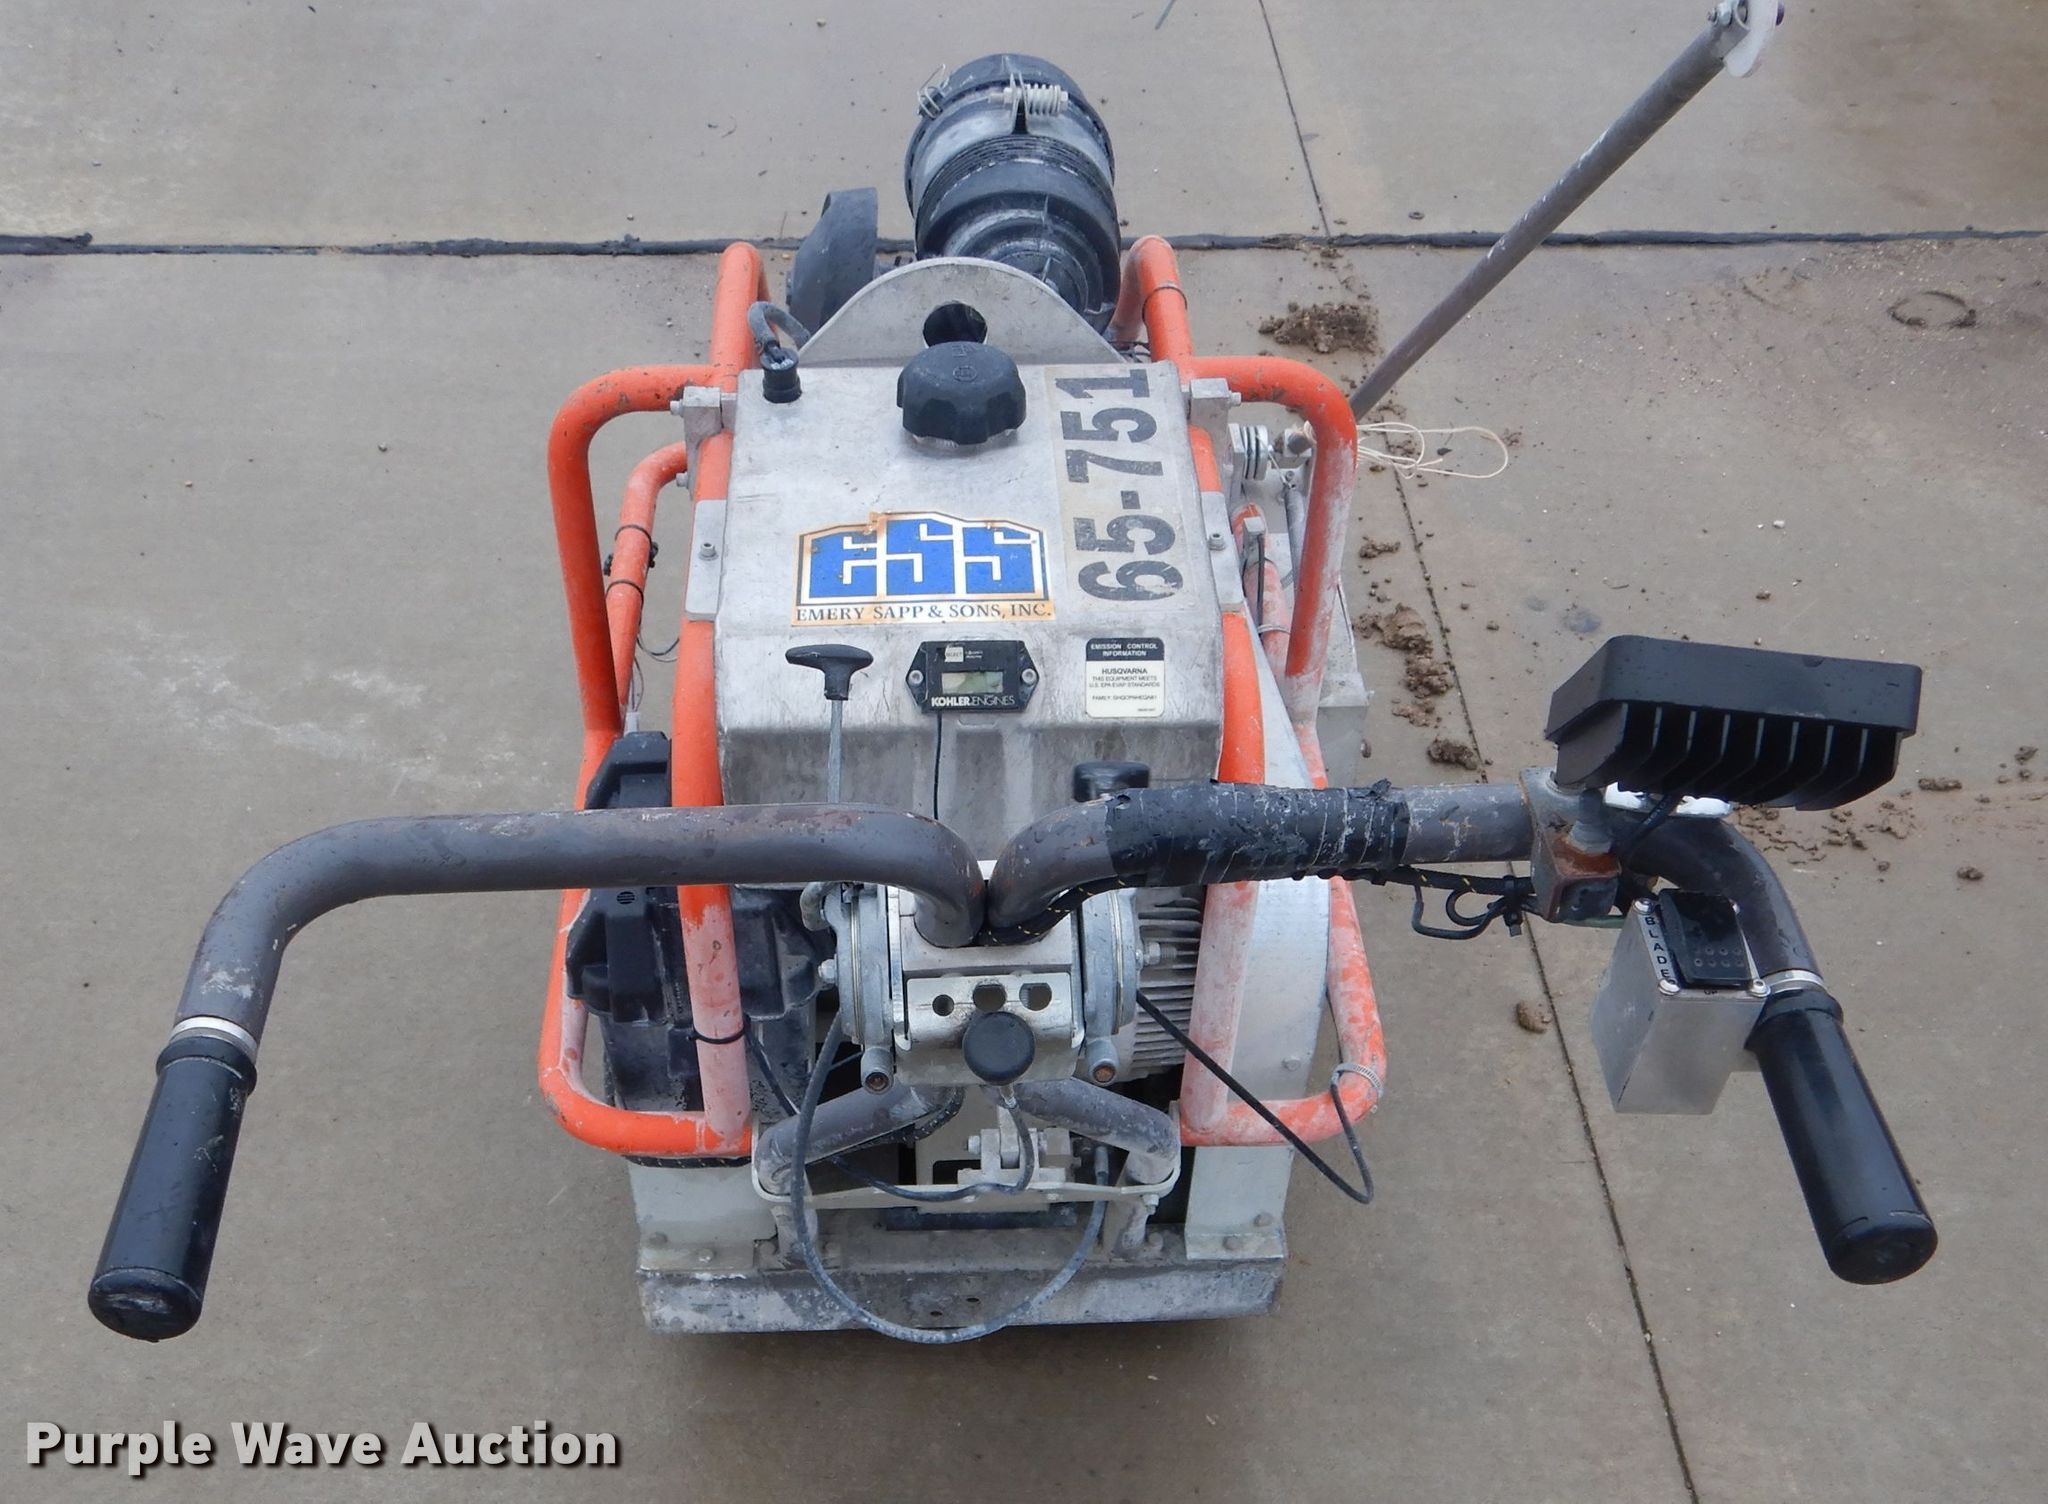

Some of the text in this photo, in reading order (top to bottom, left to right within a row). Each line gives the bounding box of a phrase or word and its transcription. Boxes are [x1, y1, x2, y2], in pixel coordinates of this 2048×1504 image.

[1055, 368, 1184, 602] 65-751
[796, 602, 1052, 622] EMERY SAPP & SONS, INC.
[1101, 667, 1148, 675] HUSQVARNA
[931, 696, 970, 708] KOHLER
[1644, 915, 1672, 979] BLADE
